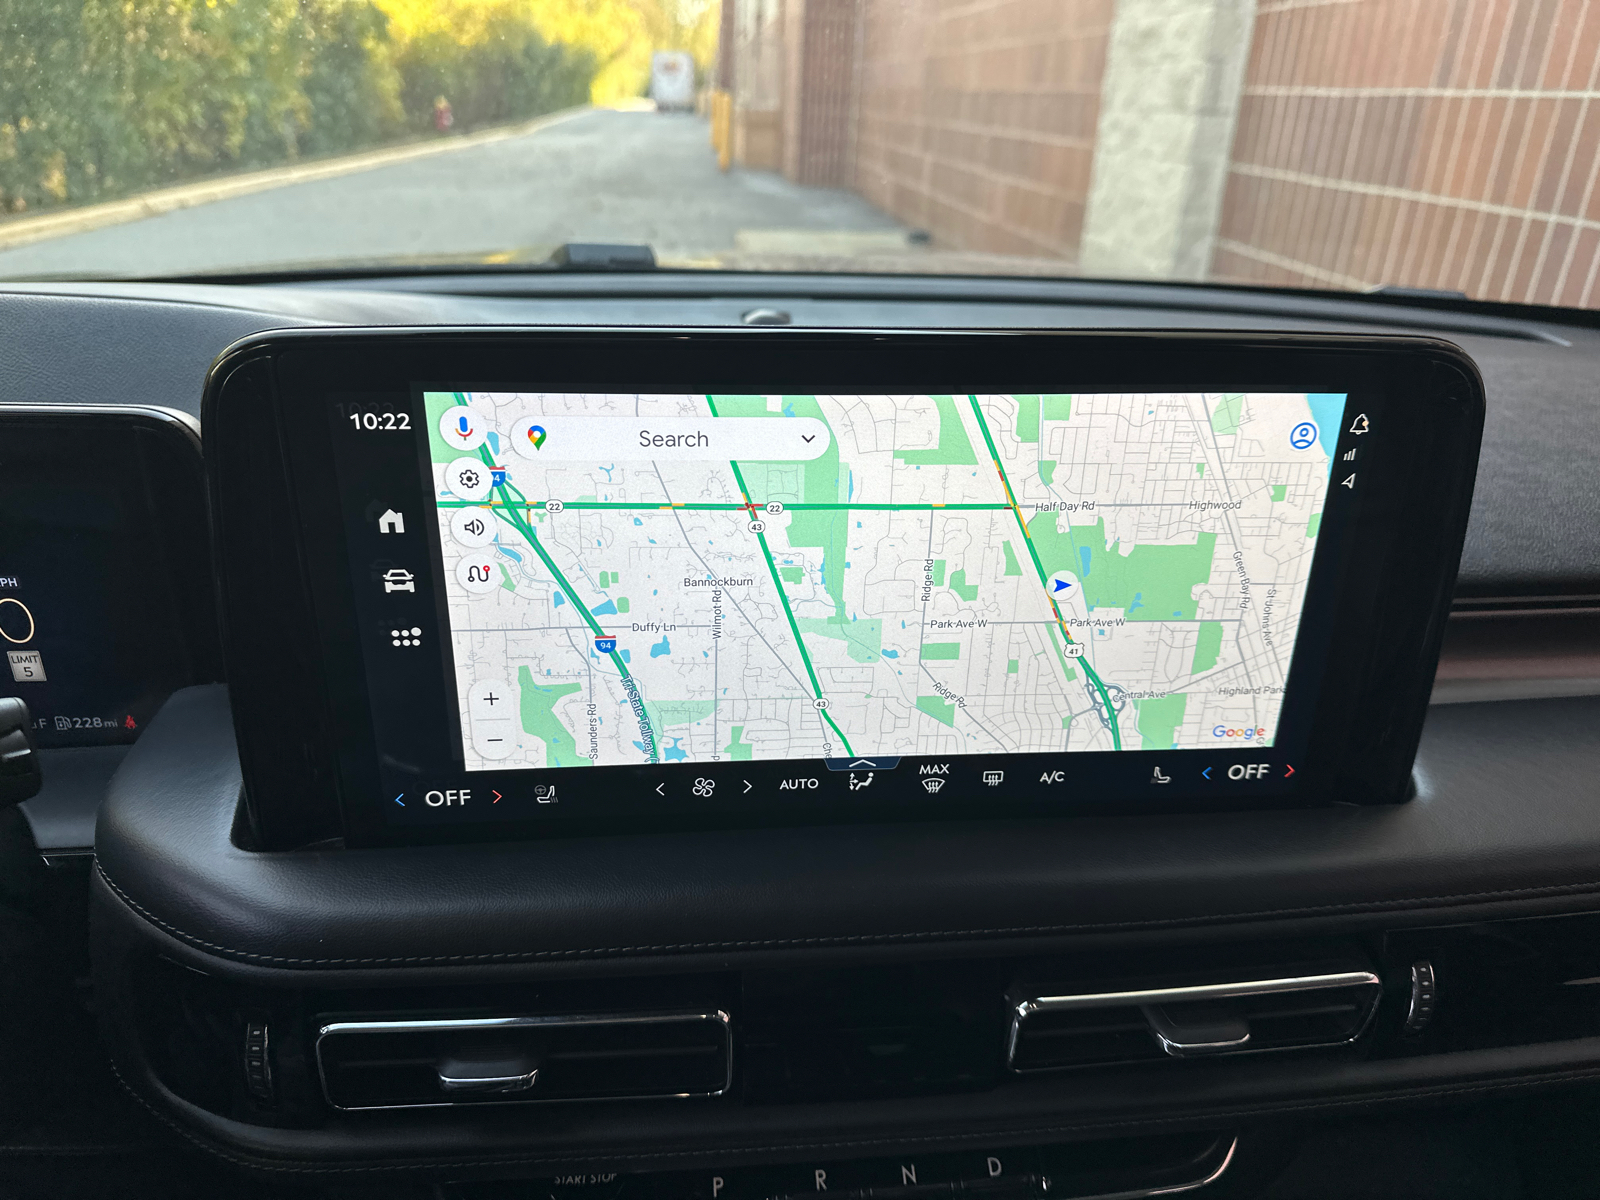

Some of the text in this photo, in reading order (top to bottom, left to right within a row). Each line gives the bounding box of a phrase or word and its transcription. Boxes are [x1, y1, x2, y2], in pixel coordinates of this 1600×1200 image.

[349, 412, 412, 431] 10:22
[638, 430, 710, 448] Search
[548, 502, 561, 511] 22
[768, 503, 782, 513] 22
[1035, 500, 1096, 513] Half Day Rd
[1188, 500, 1242, 512] Highwood
[751, 522, 764, 532] 43
[683, 576, 754, 587] Bannockburn
[920, 558, 935, 602] Ridge Rd
[1233, 550, 1251, 610] Green Bay Rd
[711, 589, 722, 640] Wilmot Rd
[1261, 588, 1277, 647] St Johns Ave
[631, 622, 677, 634] Duffy Ln
[930, 618, 988, 629] Park Ave W
[1069, 617, 1126, 628] Park Ave W
[600, 641, 612, 650] 94
[11, 655, 39, 664] LIMIT
[23, 666, 34, 678] 5
[932, 681, 968, 709] Ridge Rd
[1112, 690, 1166, 703] Central Ave
[1218, 686, 1261, 697] Highland
[816, 700, 827, 709] 43
[620, 673, 645, 718] Tri-State
[638, 716, 656, 756] Tollway
[72, 717, 119, 728] 228 mi
[586, 703, 599, 760] Saunders Rd
[1212, 724, 1266, 740] Google
[918, 763, 950, 775] MAX
[1226, 762, 1271, 781] OFF
[1039, 770, 1066, 784] A/C
[779, 778, 819, 790] AUTO
[424, 789, 472, 807] OFF
[987, 1156, 1002, 1177] D
[814, 1169, 828, 1192] R
[901, 1163, 918, 1186] N
[712, 1176, 725, 1199] P
